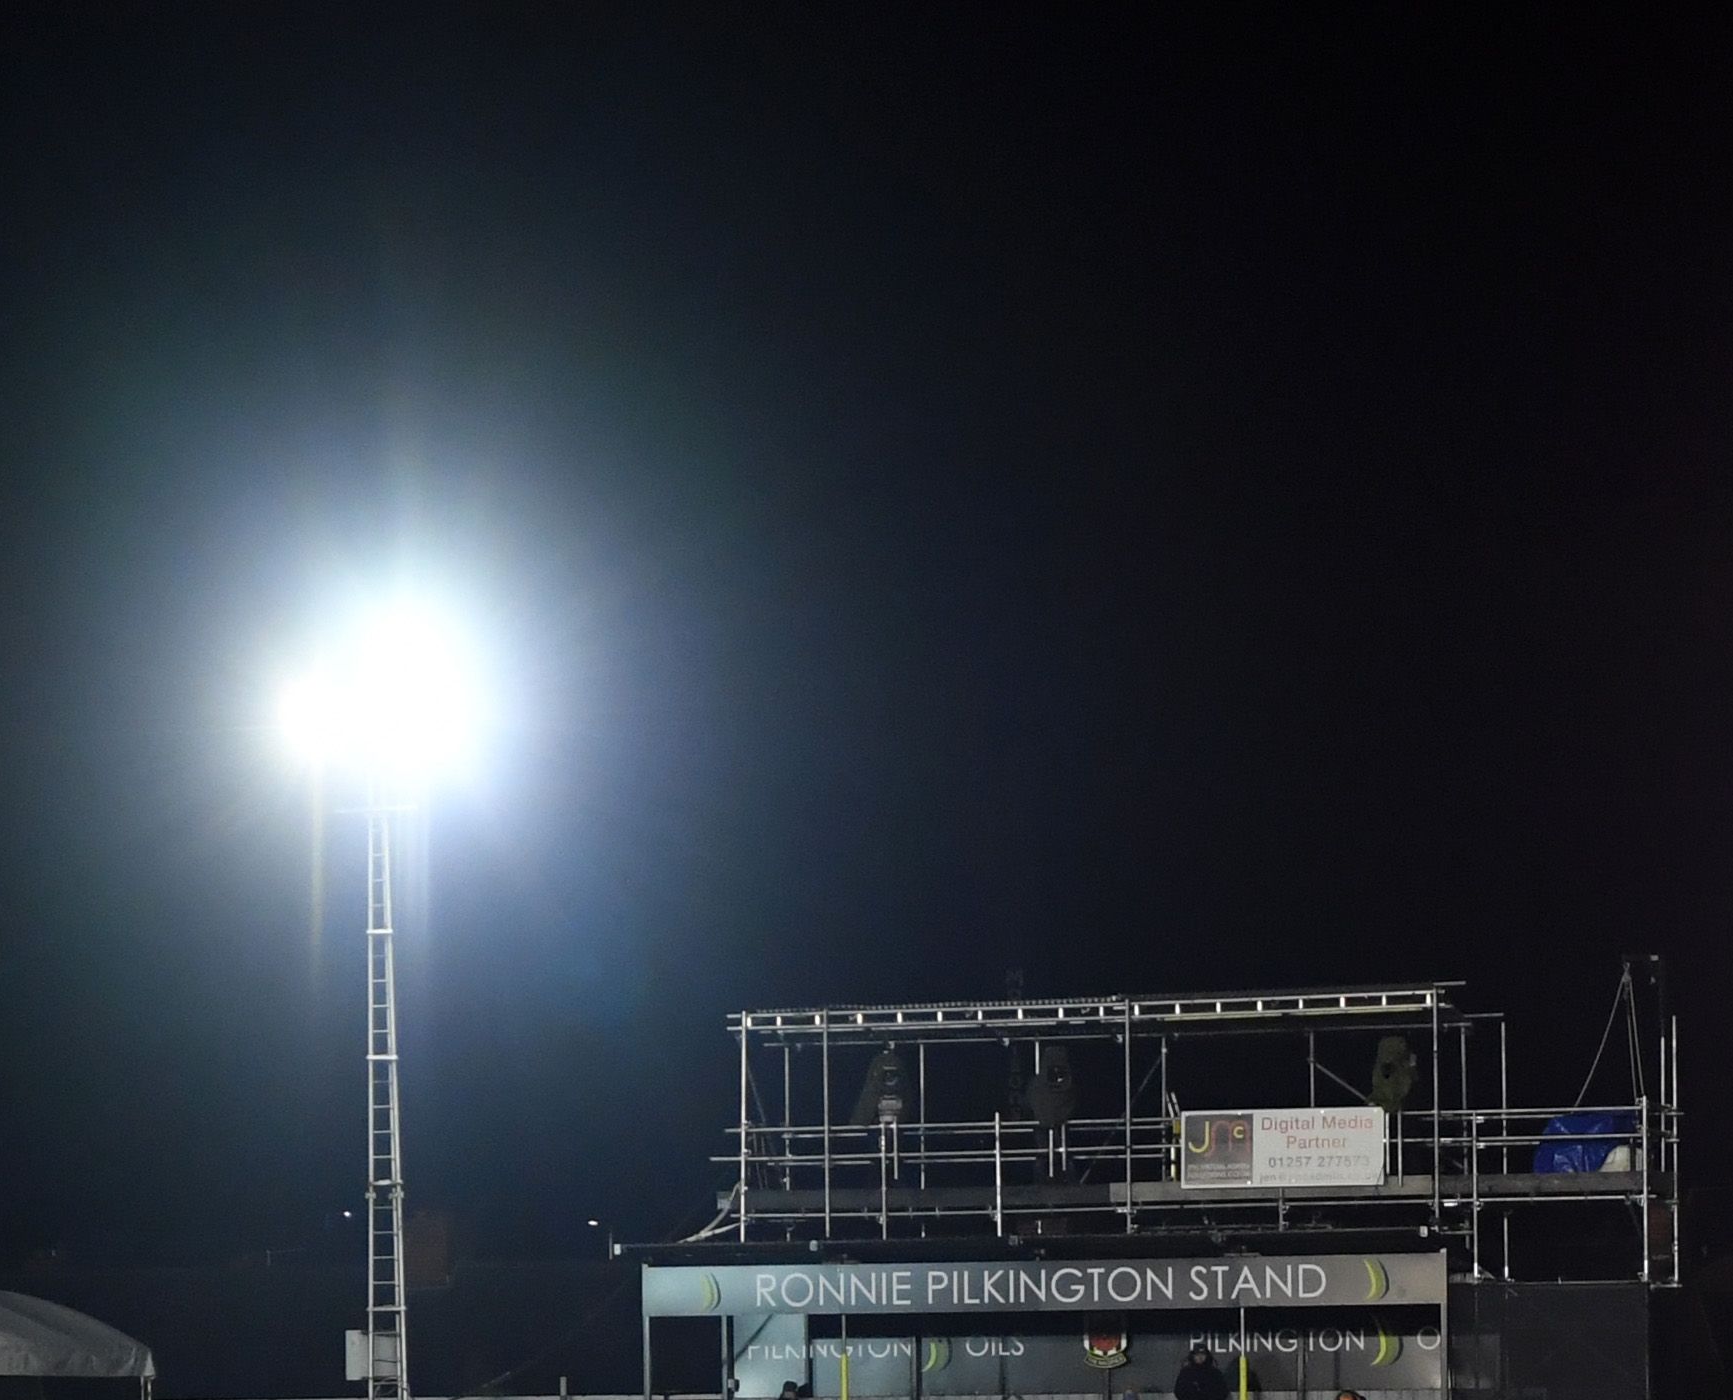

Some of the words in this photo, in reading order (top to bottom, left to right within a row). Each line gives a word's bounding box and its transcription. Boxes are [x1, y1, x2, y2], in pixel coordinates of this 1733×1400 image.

[1261, 1117, 1315, 1137] Digital
[1322, 1115, 1374, 1133] Media
[1287, 1135, 1347, 1151] Partner
[1268, 1157, 1311, 1168] 01257
[755, 1269, 912, 1308] RONNIE
[927, 1265, 1173, 1306] PILKINGTON
[1188, 1262, 1327, 1302] STAND
